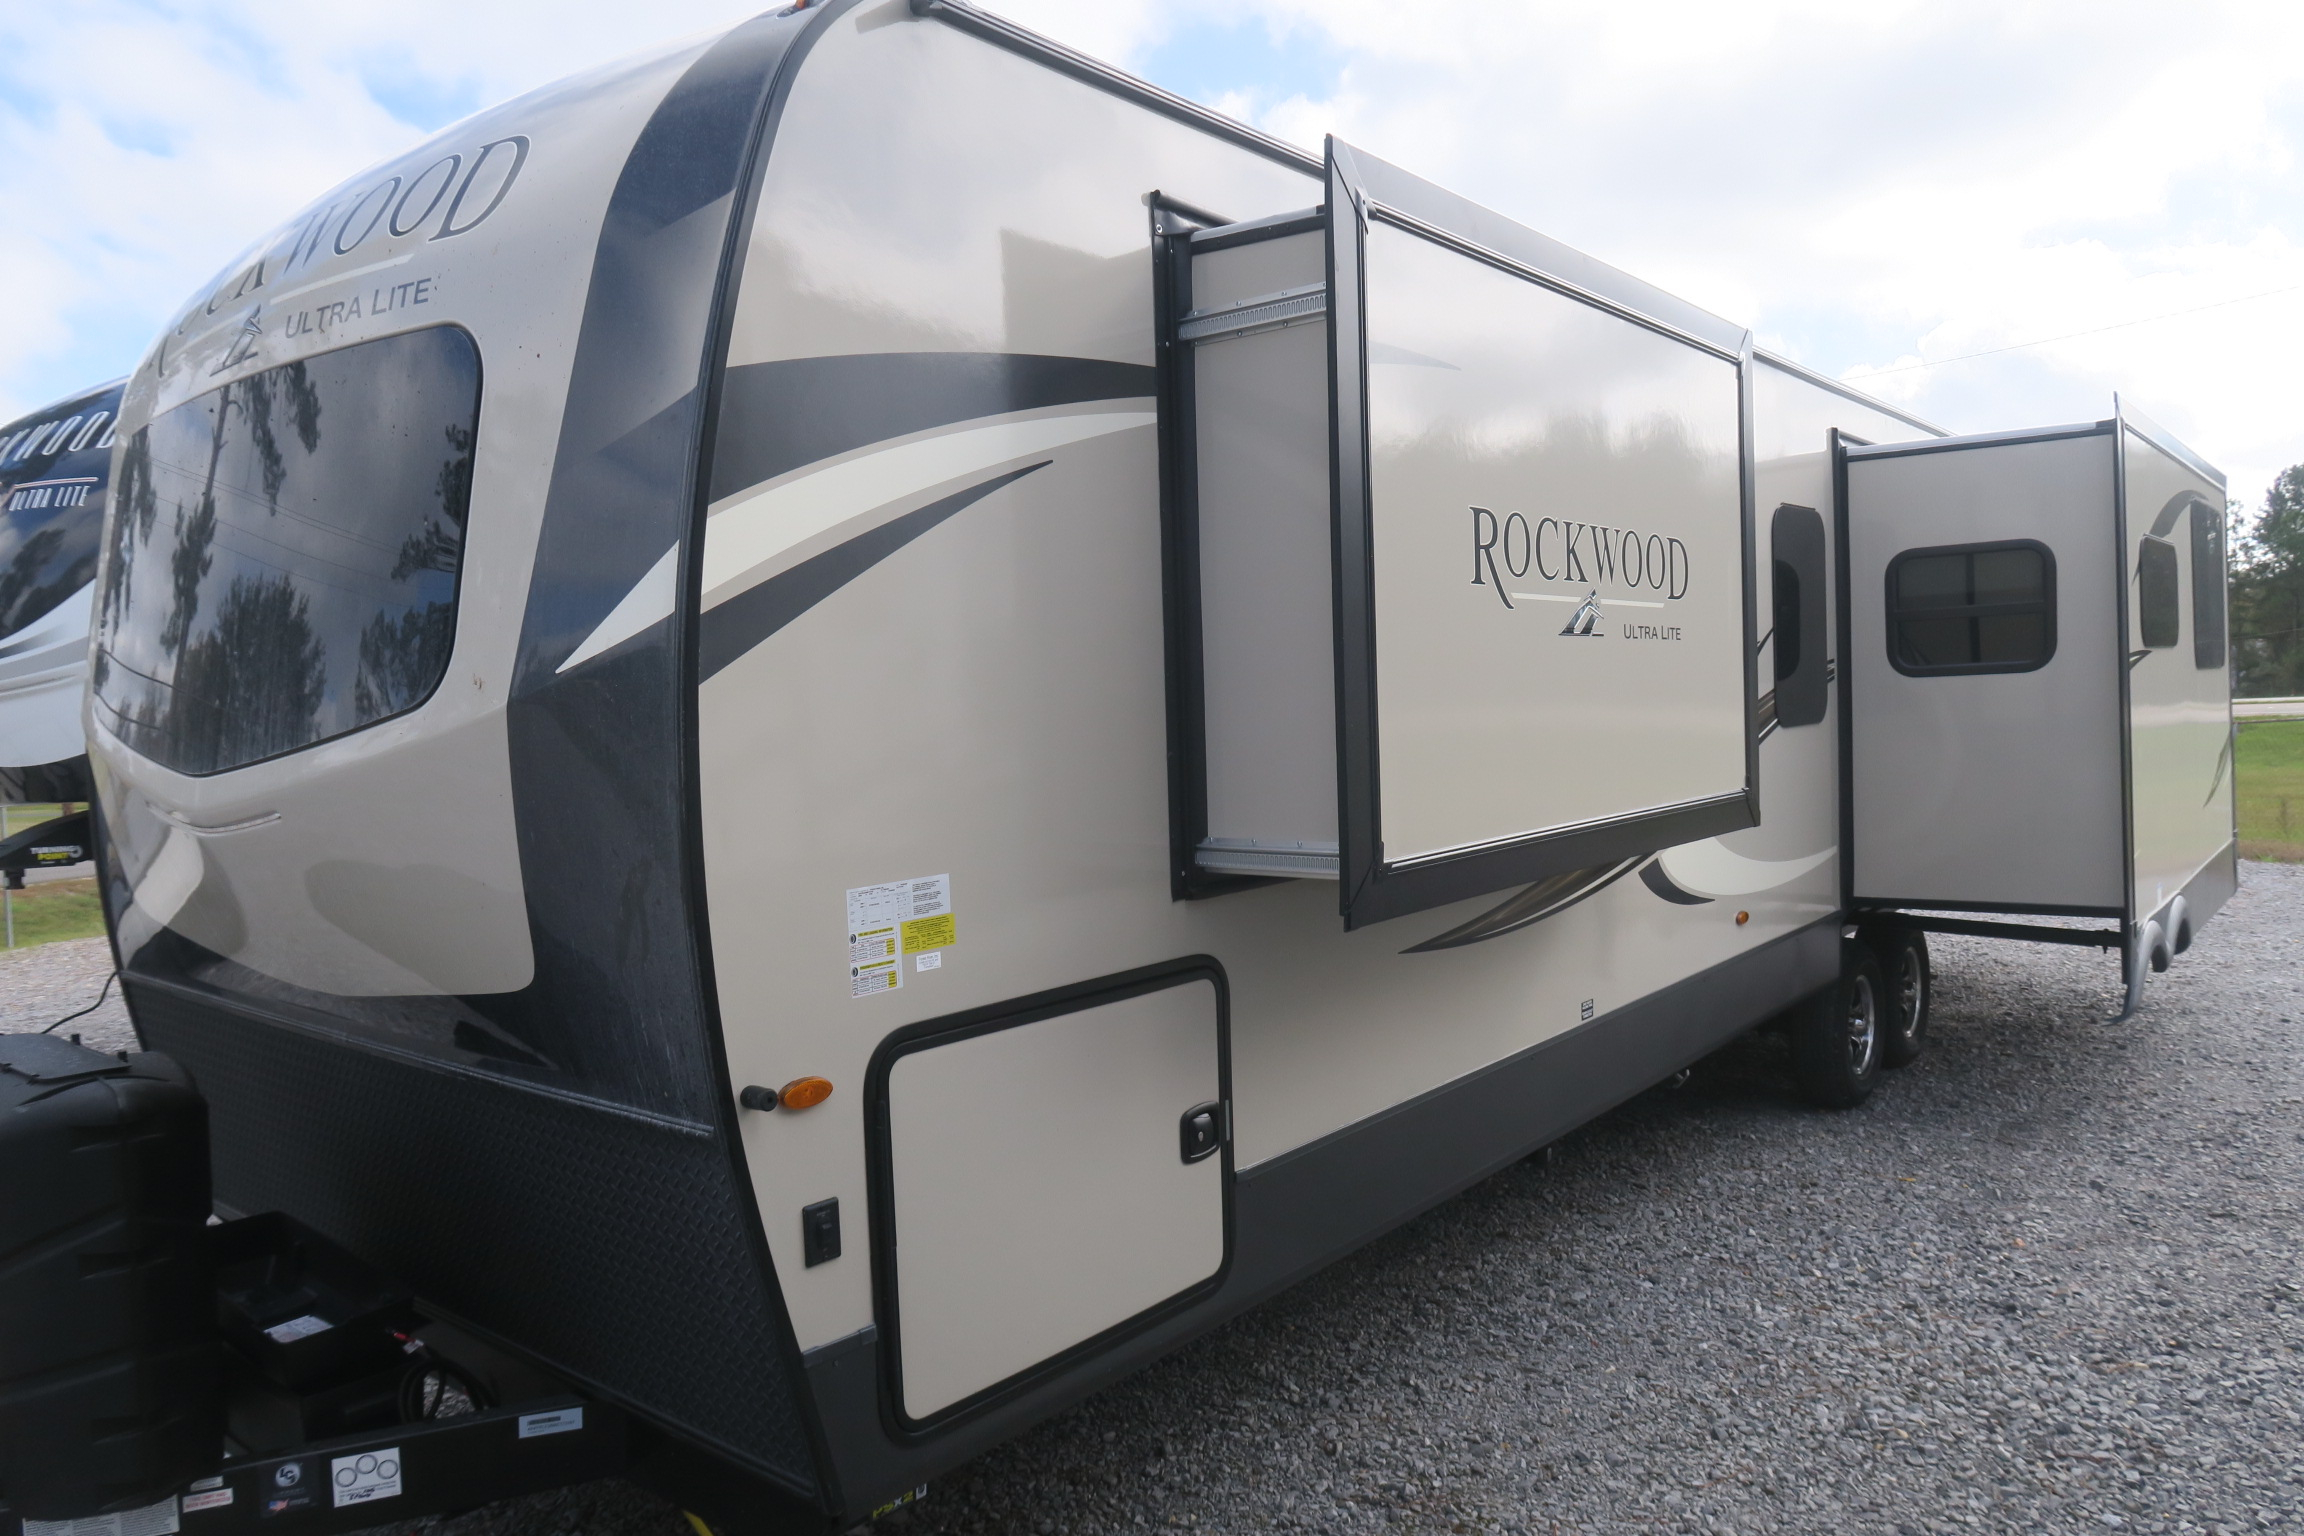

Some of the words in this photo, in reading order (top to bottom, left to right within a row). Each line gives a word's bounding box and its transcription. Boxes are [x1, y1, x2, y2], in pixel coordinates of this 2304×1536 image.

[284, 294, 362, 338] ULTRA
[371, 277, 432, 316] LITE
[9, 487, 53, 511] ULTRA
[54, 485, 91, 507] LITE
[1468, 505, 1690, 610] ROCKWOOD
[1623, 623, 1658, 640] ULTRA
[1661, 625, 1682, 641] LITE
[37, 852, 69, 860] POINT
